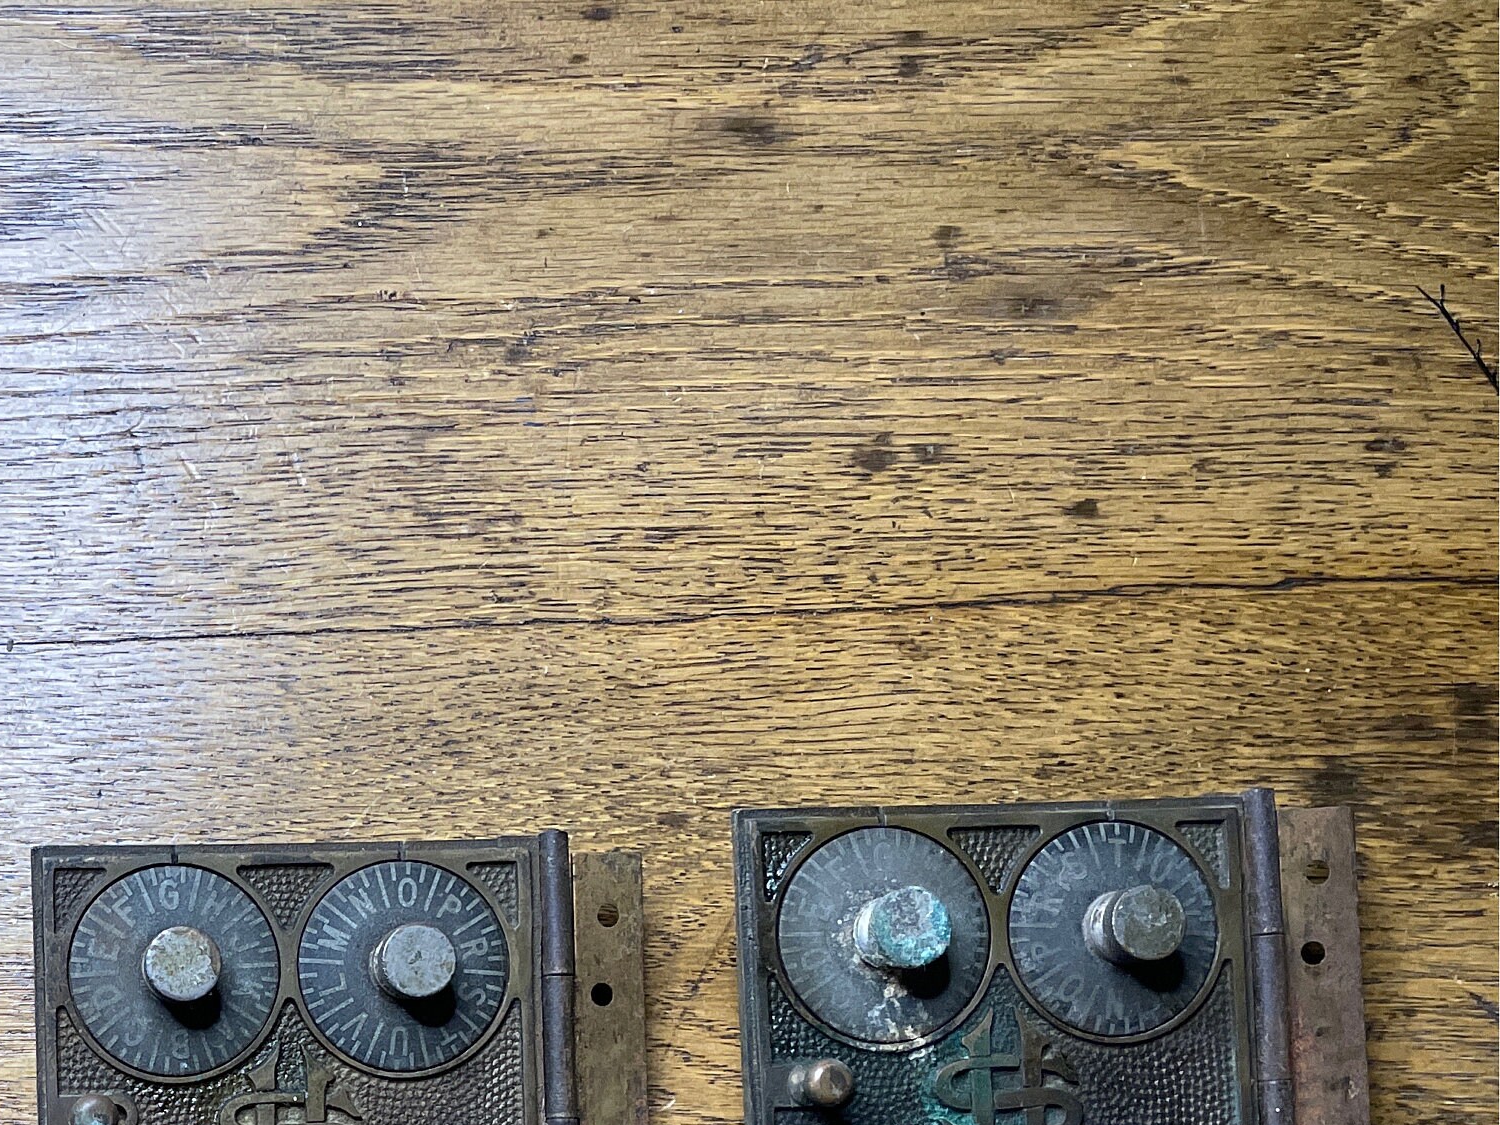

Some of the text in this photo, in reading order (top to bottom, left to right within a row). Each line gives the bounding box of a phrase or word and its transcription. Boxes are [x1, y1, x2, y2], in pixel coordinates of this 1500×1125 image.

[1107, 838, 1127, 867] T
[111, 896, 137, 928] F
[159, 879, 180, 910] G
[348, 889, 377, 919] N
[398, 877, 418, 908] O
[436, 894, 462, 918] P
[317, 924, 351, 952] M
[460, 937, 489, 960] R
[319, 972, 347, 997] L
[340, 1012, 369, 1040] V
[389, 1026, 408, 1056] U
